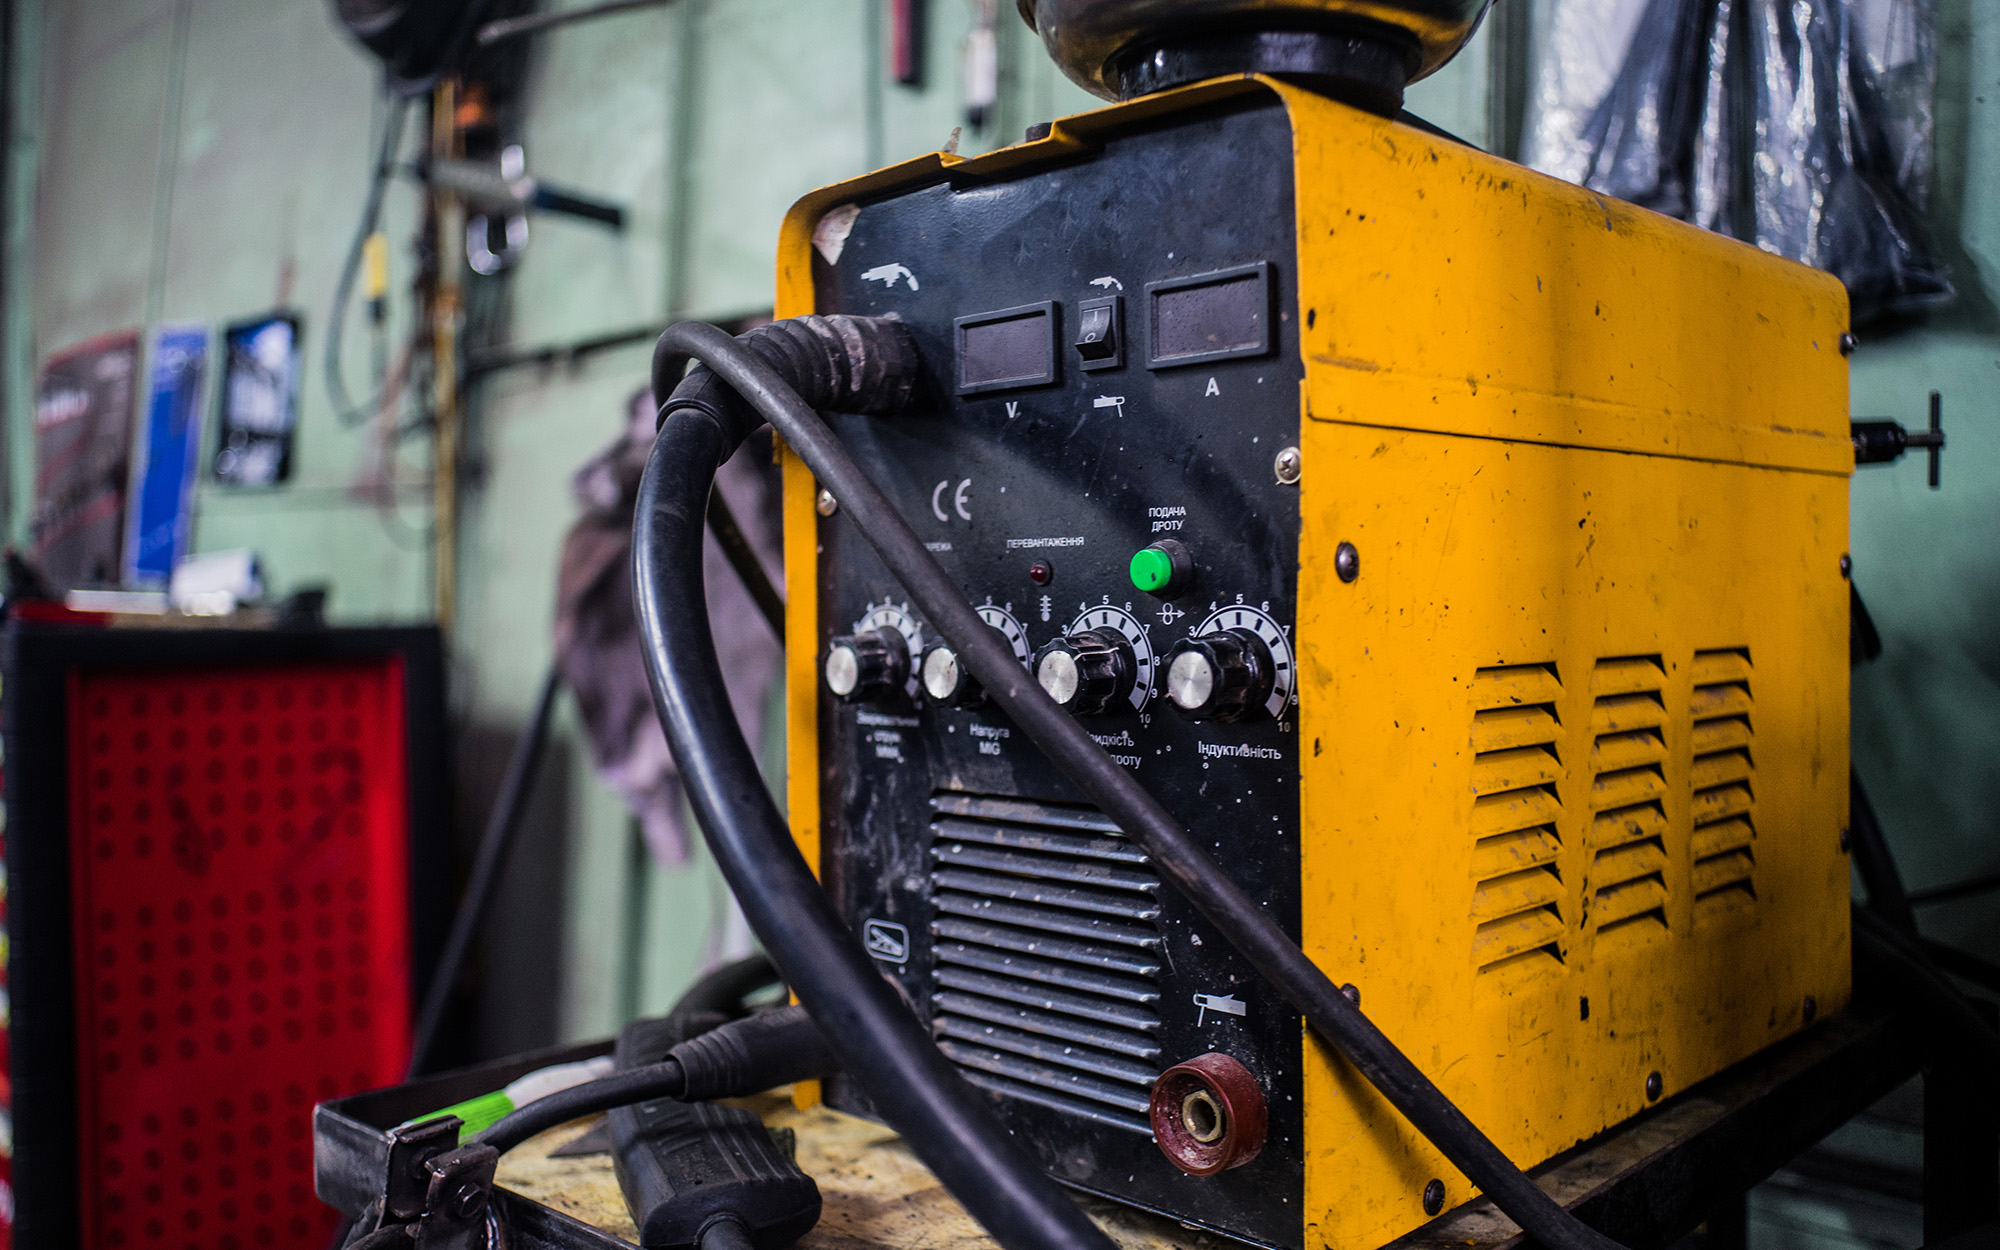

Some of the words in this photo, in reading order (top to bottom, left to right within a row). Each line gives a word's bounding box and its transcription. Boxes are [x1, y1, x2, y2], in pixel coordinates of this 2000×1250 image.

[1205, 377, 1220, 397] A
[1005, 401, 1018, 419] V
[932, 478, 971, 522] CE
[1149, 506, 1187, 518] ПОДАЧА
[1151, 520, 1185, 532] ДРОТУ
[1007, 537, 1084, 548] ПЕРЕВАНТАЖЕННЯ
[1102, 595, 1109, 605] 5
[1236, 594, 1243, 604] 5
[1079, 602, 1086, 611] 4
[1125, 602, 1132, 612] 6
[1209, 602, 1217, 612] 4
[1262, 601, 1269, 612] 6
[985, 595, 993, 606] 5
[1005, 602, 1012, 612] 6
[1022, 622, 1028, 633] 7
[1062, 625, 1068, 635] 3
[1143, 624, 1150, 634] 7
[1189, 626, 1196, 636] 3
[1282, 625, 1290, 636] 7
[1153, 656, 1160, 666] 8
[1151, 688, 1158, 698] 9
[1291, 695, 1298, 705] 9
[1140, 714, 1151, 723] 10
[970, 723, 1009, 740] Напруга
[1278, 722, 1291, 732] 10
[979, 741, 1000, 755] MIG
[1198, 741, 1281, 759] Індуктивність
